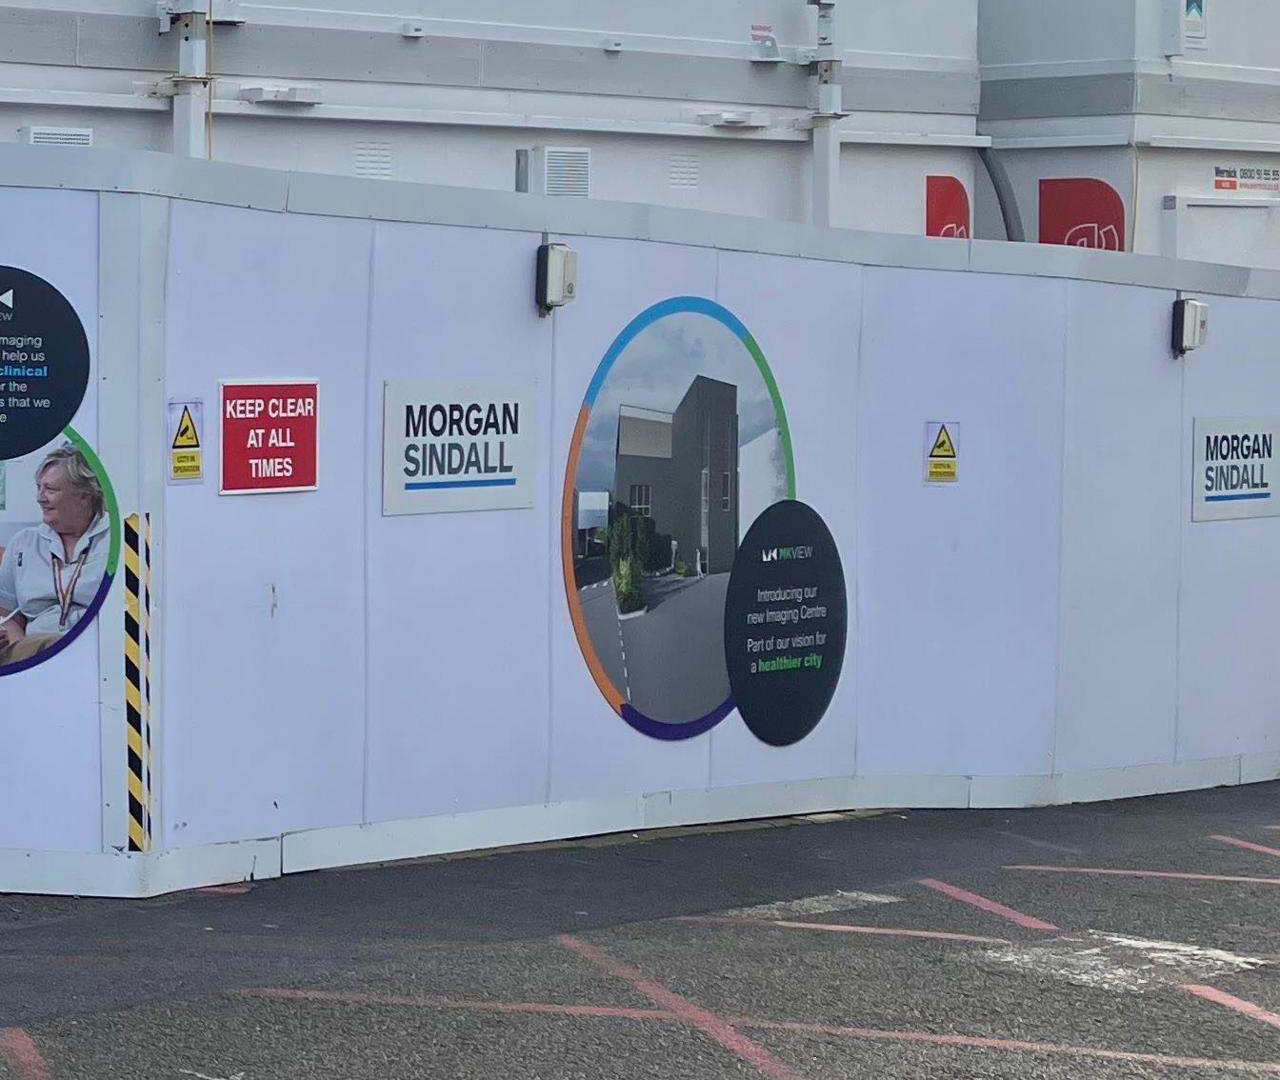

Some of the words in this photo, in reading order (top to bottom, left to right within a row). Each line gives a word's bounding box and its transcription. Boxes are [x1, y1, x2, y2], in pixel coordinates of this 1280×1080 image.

[2, 349, 28, 363] help
[30, 352, 46, 362] us
[8, 381, 28, 392] the
[8, 396, 30, 408] that
[33, 398, 51, 408] we
[226, 399, 264, 419] KEEP
[268, 398, 314, 418] CLEAR
[405, 403, 519, 438] MORGAN
[247, 429, 265, 448] AT
[268, 428, 295, 448] ALL
[1205, 433, 1272, 461] MORGAN
[249, 457, 293, 478] TIMES
[403, 441, 514, 477] SINDALL
[1205, 463, 1269, 491] SINDALL
[757, 586, 803, 602] Introducing
[804, 587, 818, 598] our
[746, 611, 765, 624] new
[766, 608, 799, 624] Imaging
[800, 605, 827, 619] Centre
[747, 638, 765, 652] Part
[765, 636, 775, 651] of
[776, 637, 790, 650] our
[791, 633, 814, 648] vision
[816, 631, 827, 646] for
[750, 662, 757, 673] a
[759, 656, 802, 673] healthier
[804, 653, 823, 669] city
